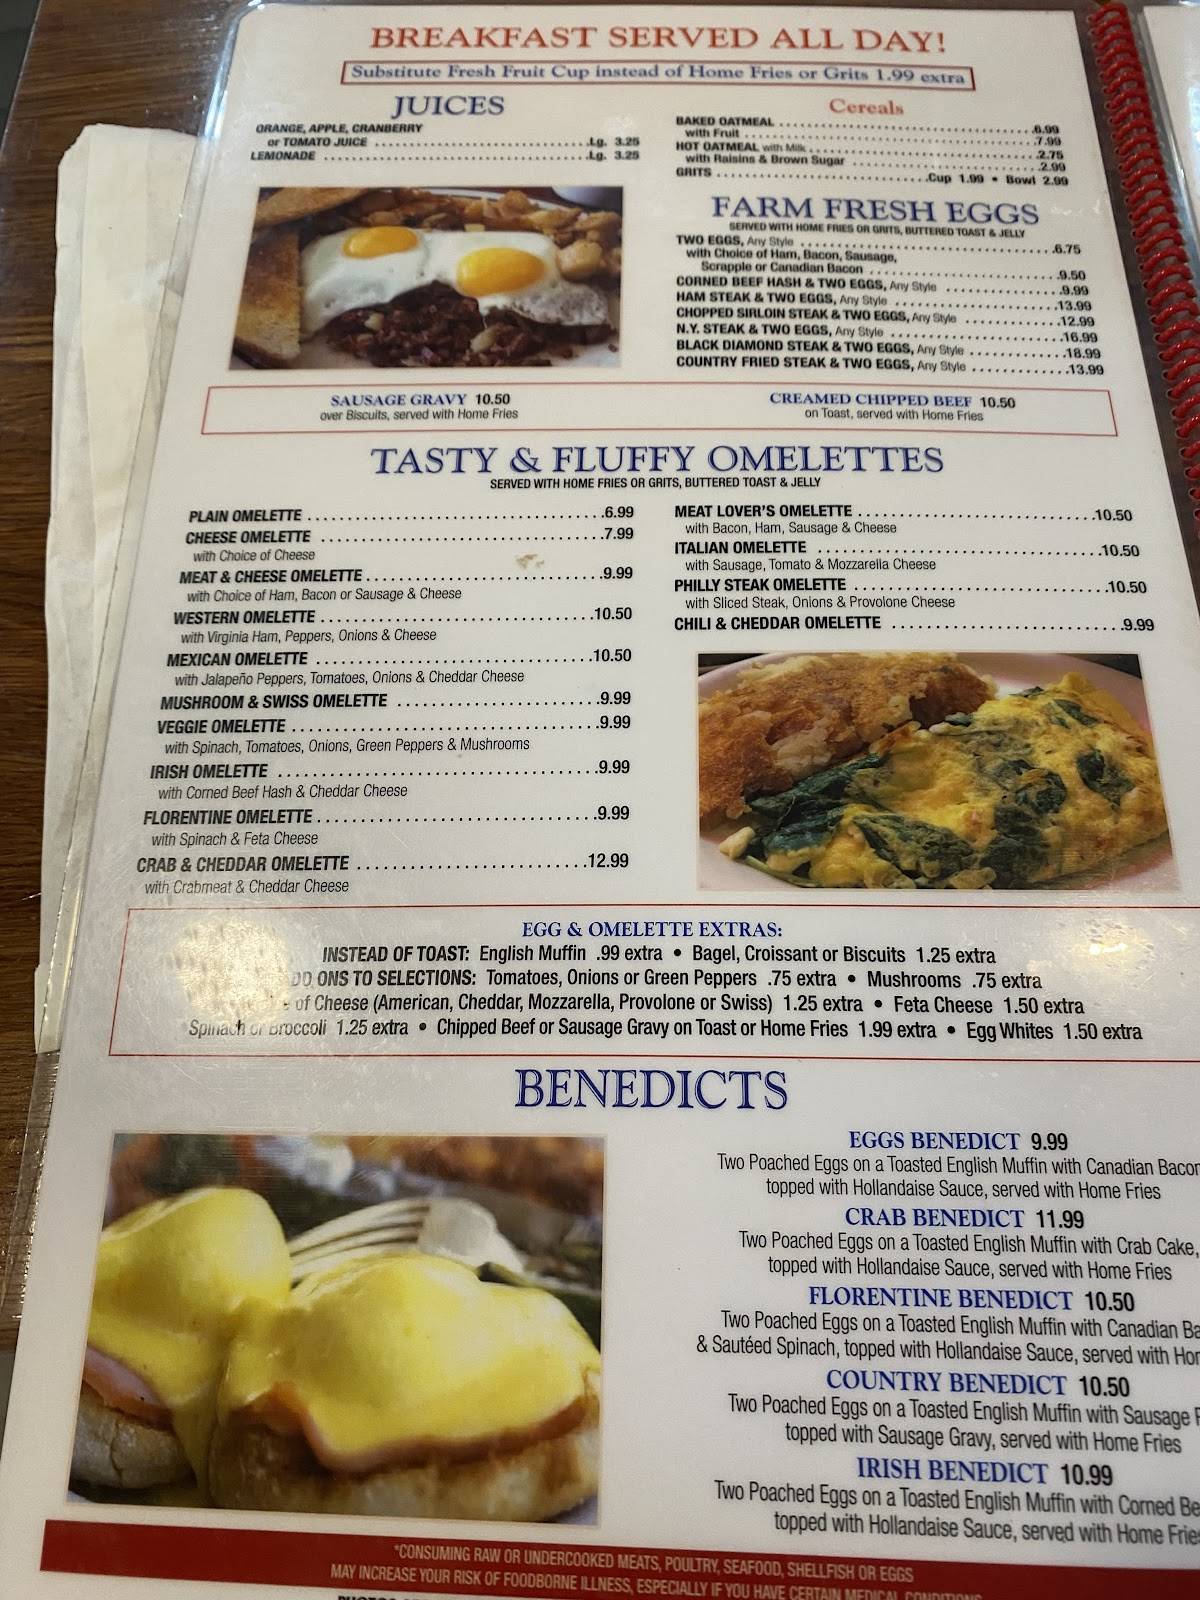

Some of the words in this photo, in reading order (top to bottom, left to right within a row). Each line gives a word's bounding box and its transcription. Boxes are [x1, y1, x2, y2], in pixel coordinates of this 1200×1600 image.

[371, 26, 598, 48] BREAKFAST
[609, 27, 758, 48] SERVED
[770, 28, 844, 50] ALL
[853, 29, 945, 53] DAY!
[352, 65, 441, 78] Substitute
[448, 64, 495, 78] Fresh
[502, 65, 544, 78] Fruit
[551, 65, 590, 79] Cup
[596, 64, 659, 77] instead
[665, 63, 684, 77] of
[689, 64, 744, 78] Home
[750, 65, 792, 79] Fries
[798, 70, 818, 80] or
[823, 67, 869, 80] Grits
[877, 68, 915, 82] 1.99
[921, 71, 965, 85] extra
[391, 96, 504, 119] JUICES
[829, 99, 904, 115] Cereals
[256, 124, 306, 135] ORANGE,
[308, 124, 349, 134] APPLE,
[352, 124, 423, 133] CRANBERRY
[676, 116, 716, 126] BAKED
[719, 117, 774, 127] OATMEAL
[267, 139, 280, 147] or
[284, 137, 331, 147] TOMATO
[333, 137, 367, 147] JUICE
[250, 151, 316, 161] LEMONADE
[676, 167, 712, 177] GRITS
[928, 173, 952, 184] Cup
[1006, 175, 1036, 185] Bowl
[712, 196, 814, 218] FARM
[823, 198, 936, 222] FRESH
[945, 202, 1039, 225] EGGS
[676, 235, 704, 245] TWO
[708, 235, 744, 247] EGGS,
[747, 236, 766, 247] Any
[769, 236, 794, 248] Style
[677, 323, 700, 334] N.Y.
[703, 323, 745, 334] STEAK
[749, 324, 758, 335] &
[761, 324, 790, 335] TWO
[794, 324, 832, 337] EGGS,
[835, 326, 855, 338] Any
[858, 326, 884, 339] Style
[331, 394, 406, 406] SAUSAGE
[410, 394, 467, 405] GRAVY
[320, 412, 343, 421] over
[346, 409, 390, 421] Biscuits,
[393, 408, 429, 420] served
[432, 408, 454, 420] with
[457, 408, 489, 419] Home
[492, 408, 518, 419] Fries
[370, 447, 498, 474] TASTY
[510, 447, 542, 473] &
[552, 446, 695, 473] FLUFFY
[708, 445, 943, 473] OMELETTES
[490, 478, 531, 489] SERVED
[533, 478, 560, 489] WITH
[563, 478, 594, 489] HOME
[597, 478, 627, 488] FRIES
[630, 477, 645, 488] OR
[648, 477, 682, 489] GRITS,
[685, 477, 740, 488] BUTTERED
[742, 477, 777, 487] TOAST
[780, 477, 788, 487] &
[791, 477, 821, 487] JELLY
[189, 510, 229, 523] PLAIN
[232, 509, 302, 522] OMELETTE
[675, 505, 713, 518] MEAT
[717, 504, 775, 517] LOVER'S
[779, 504, 852, 517] OMELETTE
[179, 571, 218, 584] MEAT
[220, 570, 231, 583] &
[235, 570, 287, 583] CHEESE
[290, 569, 362, 582] OMELETTE
[187, 590, 210, 602] with
[213, 589, 252, 602] Choice
[254, 589, 267, 601] of
[269, 589, 298, 602] Ham,
[301, 588, 336, 601] Bacon
[340, 590, 352, 600] or
[355, 588, 404, 602] Sausage
[407, 587, 416, 600] &
[420, 587, 462, 599] Cheese
[157, 720, 208, 734] VEGGIE
[211, 719, 286, 733] OMELETTE
[600, 715, 631, 729] 9.99
[137, 857, 177, 873] CRAB
[180, 857, 192, 872] &
[196, 856, 267, 872] CHEDDAR
[271, 855, 349, 871] OMELETTE
[588, 853, 629, 868] 12.99
[522, 922, 562, 937] EGG
[567, 922, 583, 937] &
[589, 921, 693, 937] OMELETTE
[698, 922, 782, 937] EXTRAS:
[323, 946, 388, 963] INSTEAD
[393, 946, 413, 962] OF
[417, 945, 469, 962] TOAST:
[480, 945, 533, 964] English
[539, 944, 586, 961] Muffin
[597, 945, 620, 961] .99
[625, 945, 663, 961] extra
[693, 945, 740, 965] Bagel,
[745, 945, 818, 962] Croissant
[822, 949, 839, 962] or
[843, 946, 906, 963] Biscuits
[916, 947, 951, 963] 1.25
[956, 948, 996, 964] extra
[515, 1069, 787, 1110] BENEDICTS
[849, 1131, 904, 1149] EGGS
[910, 1132, 1020, 1150] BENEDICT
[1031, 1133, 1068, 1151] 9.99
[766, 1178, 814, 1198] topped
[819, 1178, 848, 1195] with
[853, 1178, 935, 1196] Hollandaise
[939, 1179, 988, 1200] Sauce,
[992, 1181, 1040, 1198] served
[1044, 1181, 1074, 1198] with
[1078, 1181, 1121, 1199] Home
[1125, 1182, 1161, 1200] Fries
[809, 1286, 952, 1307] FLORENTINE
[958, 1289, 1073, 1310] BENEDICT
[1085, 1291, 1135, 1312] 10.50
[857, 1457, 922, 1480] IRISH
[928, 1460, 1048, 1484] BENEDICT
[1061, 1463, 1113, 1486] 10.99
[474, 1547, 501, 1563] RAW
[504, 1548, 521, 1564] OR
[524, 1549, 614, 1568] UNDERCOOKED
[617, 1554, 662, 1573] MEATS,
[665, 1556, 720, 1575] POULTRY,
[723, 1559, 784, 1578] SEAFOOD,
[787, 1561, 855, 1579] SHELLFISH
[858, 1565, 876, 1580] OR
[879, 1566, 914, 1583] EGGS
